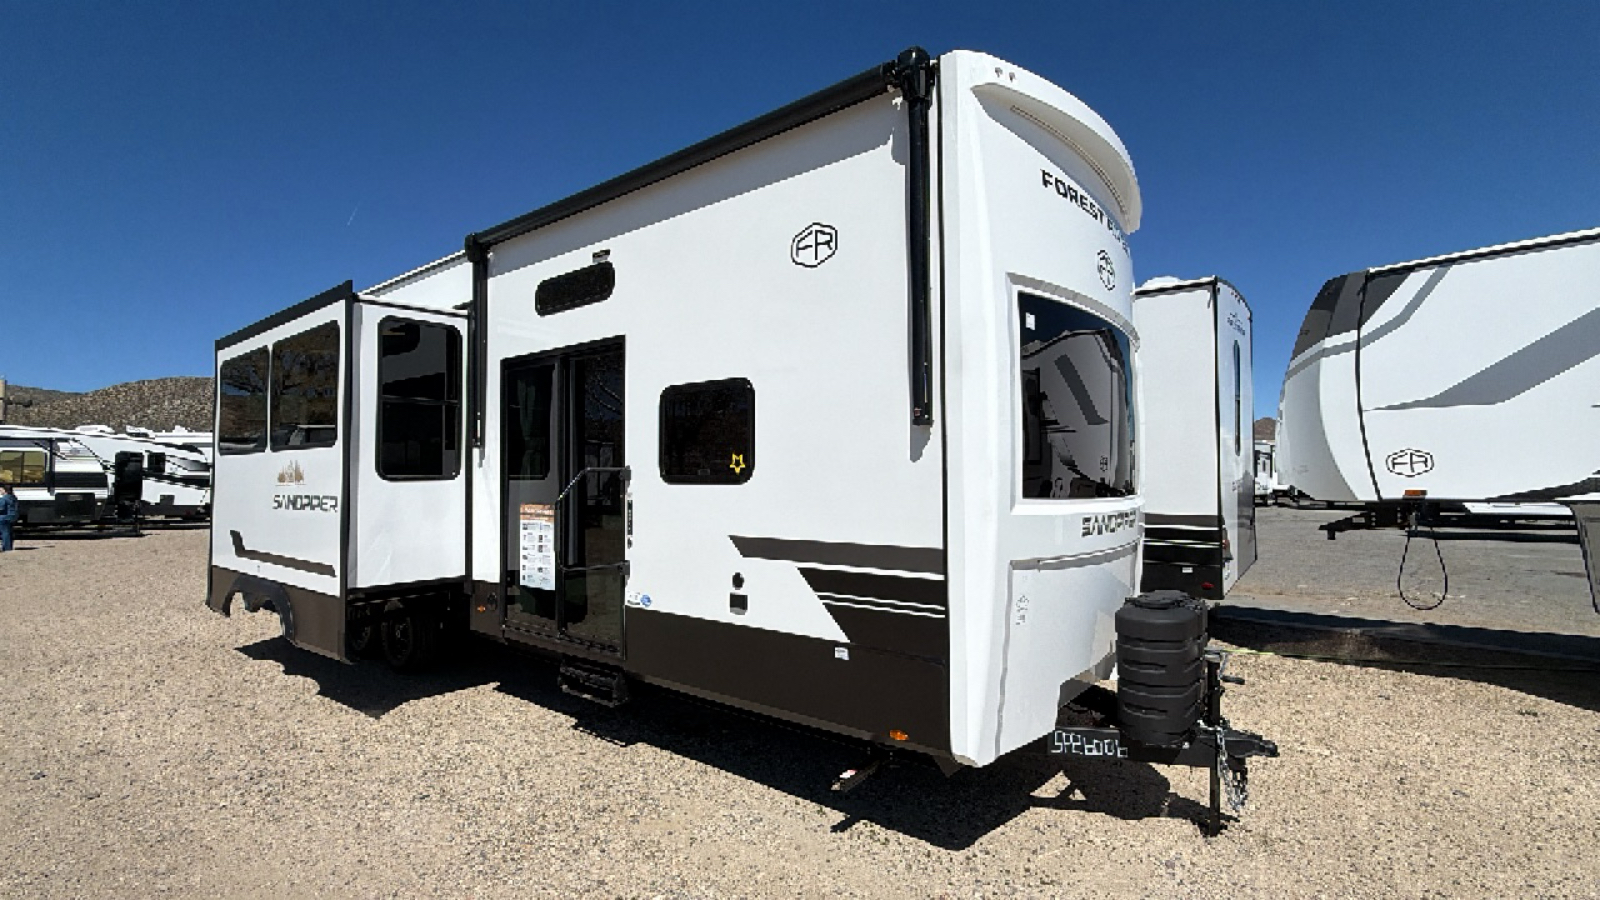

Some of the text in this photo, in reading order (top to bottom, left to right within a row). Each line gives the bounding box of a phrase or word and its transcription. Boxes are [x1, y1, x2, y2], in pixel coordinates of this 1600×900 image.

[1041, 169, 1104, 224] FOREST
[794, 228, 835, 262] FR
[1390, 451, 1429, 474] FR
